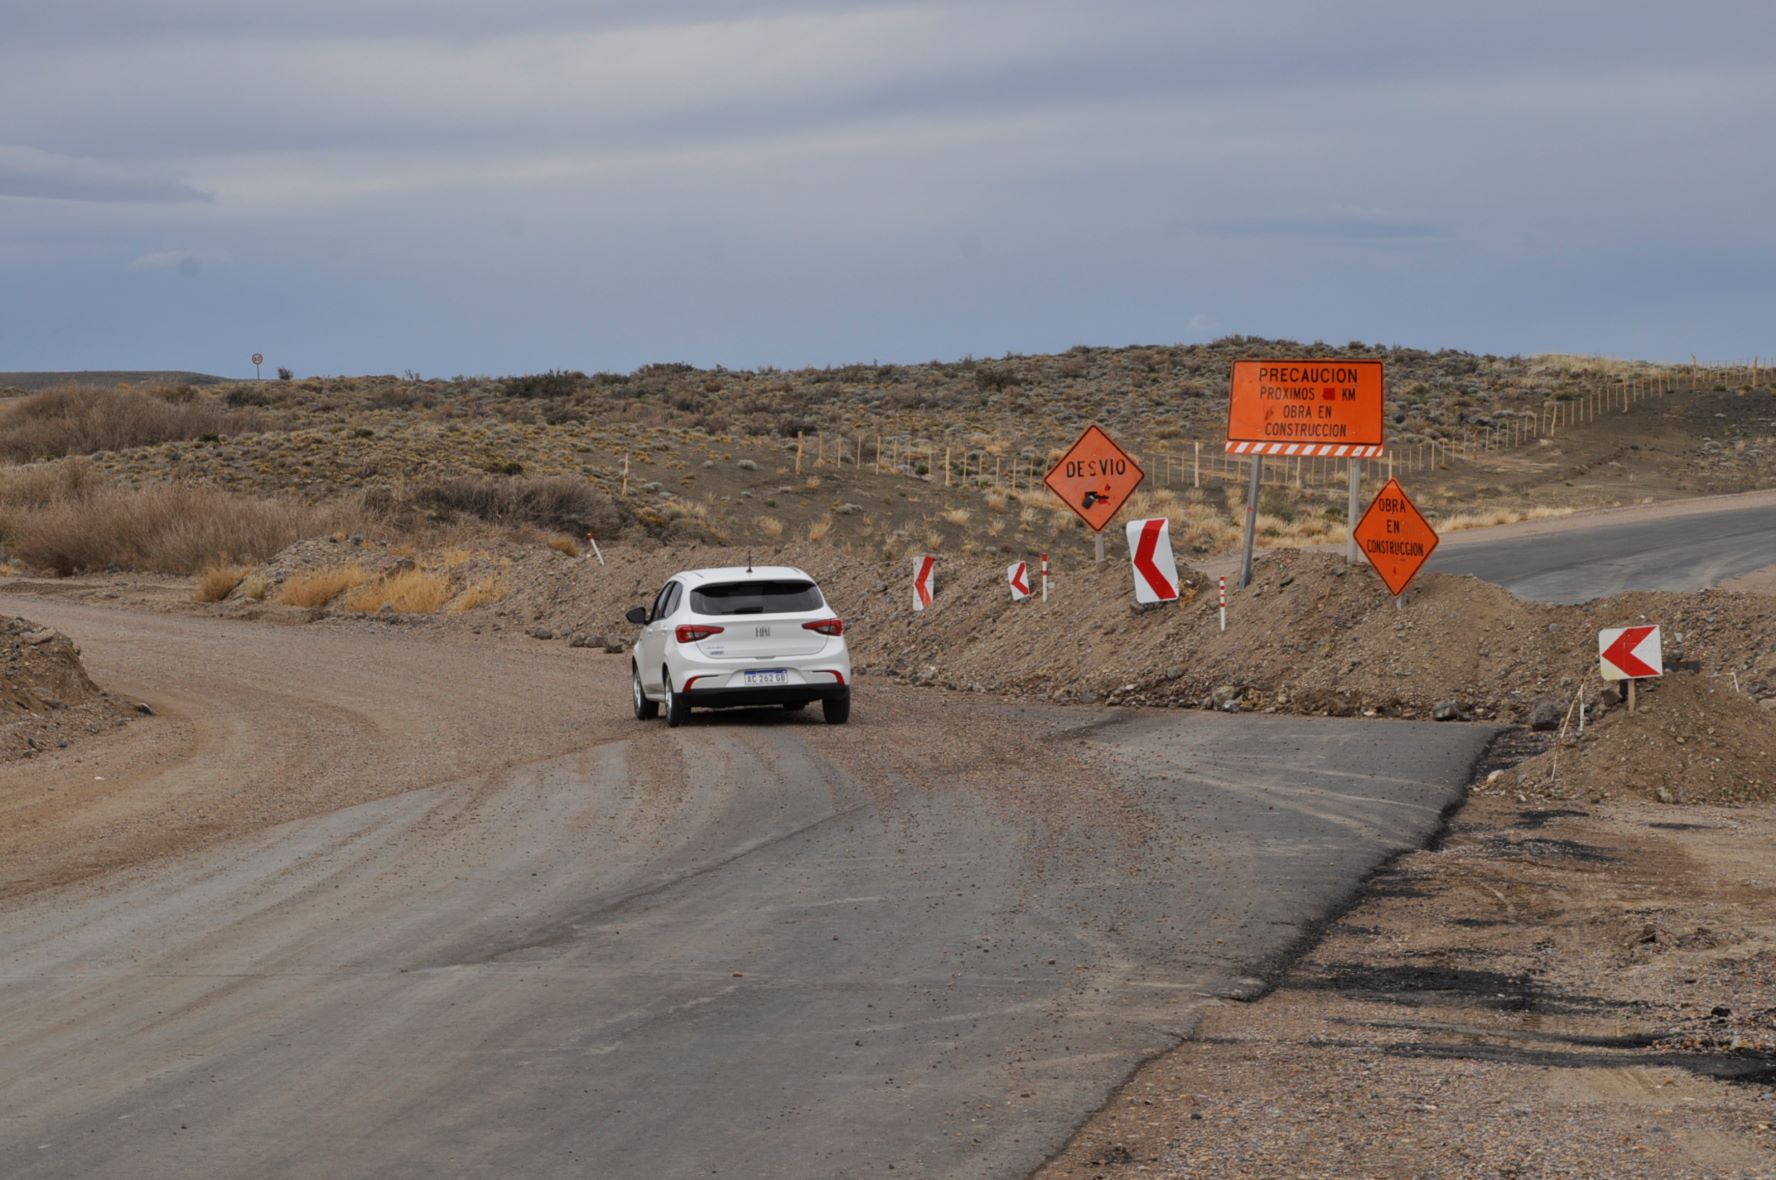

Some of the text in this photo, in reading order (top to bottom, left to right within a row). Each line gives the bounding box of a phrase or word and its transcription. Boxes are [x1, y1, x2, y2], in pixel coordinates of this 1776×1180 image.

[1259, 368, 1358, 383] PRECAUCION
[1260, 387, 1356, 401] PROXIMOS KM
[1283, 405, 1332, 418] OBRA EN
[1265, 423, 1347, 437] CONSTRUCCION
[1066, 459, 1126, 478] DESVIO
[1378, 498, 1406, 513] OBRA
[1387, 519, 1400, 534] EN
[1367, 539, 1424, 556] CONSTRUCCION
